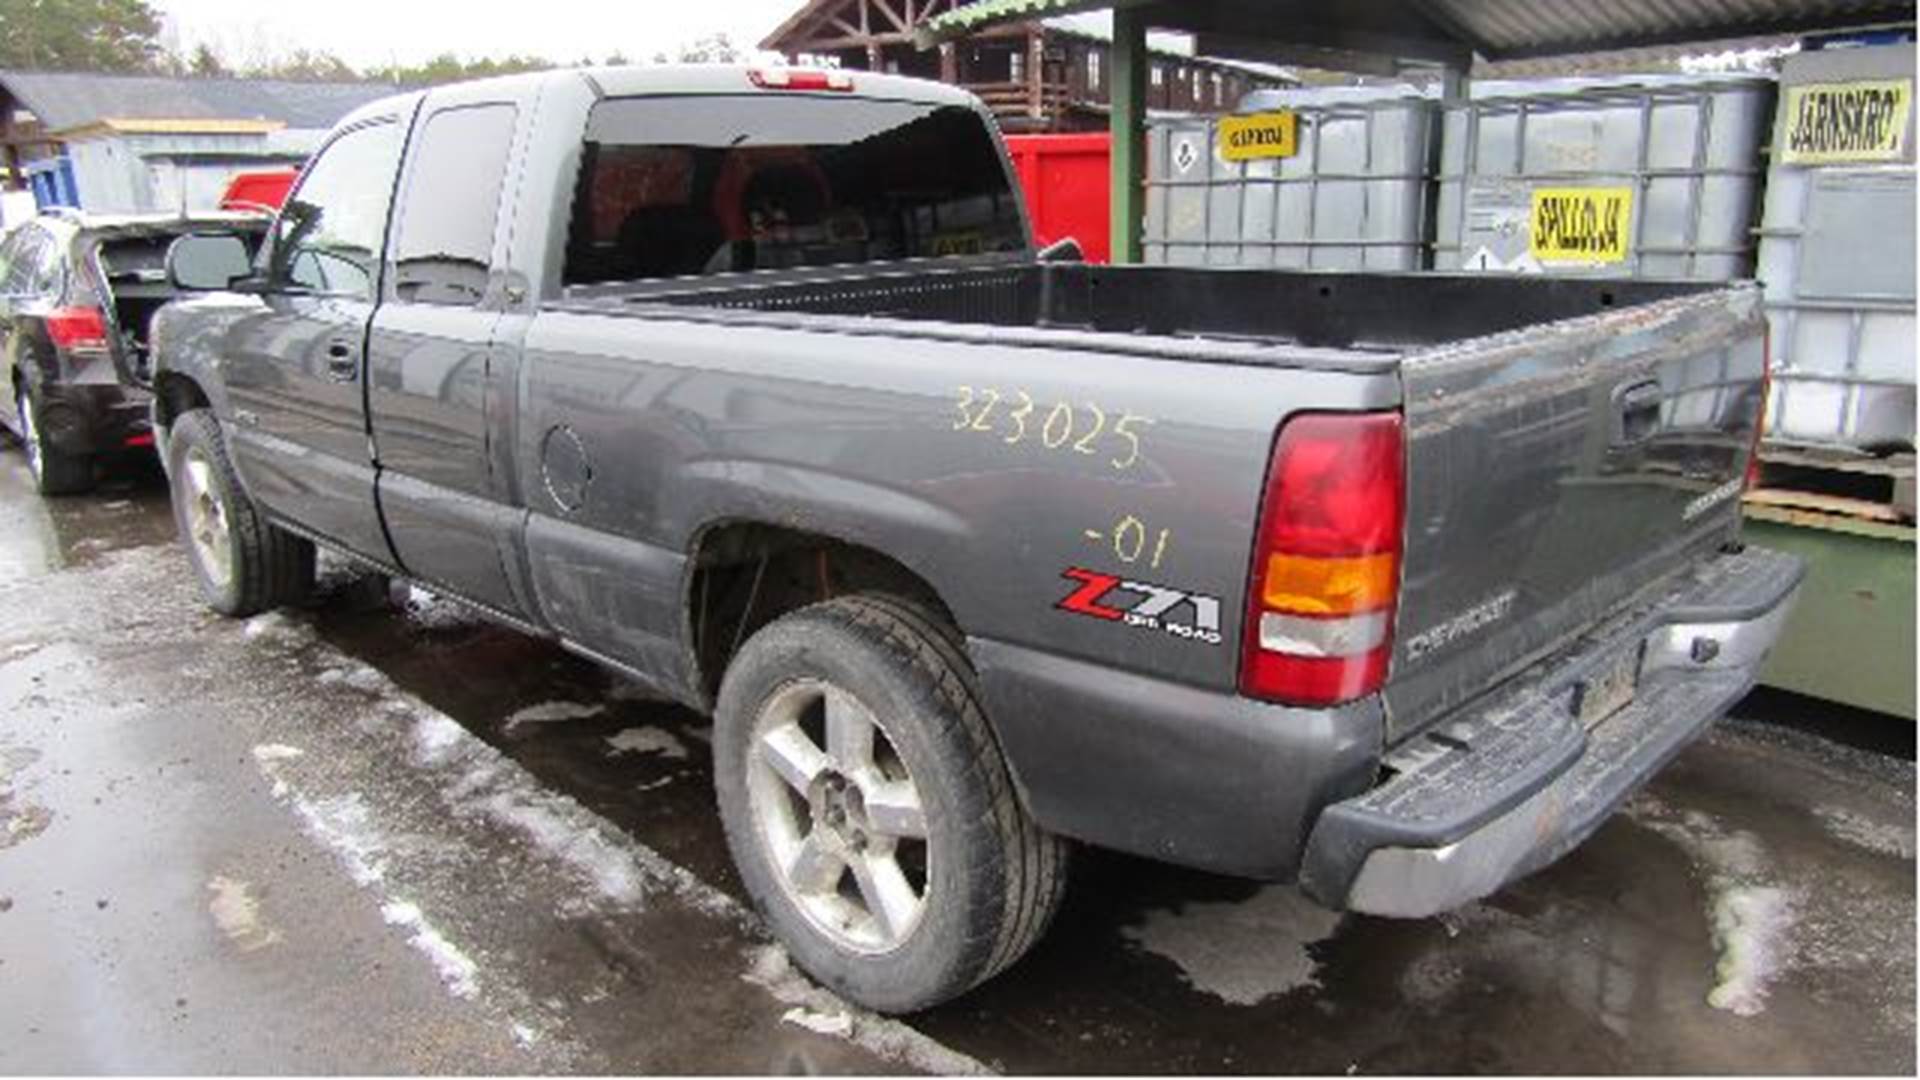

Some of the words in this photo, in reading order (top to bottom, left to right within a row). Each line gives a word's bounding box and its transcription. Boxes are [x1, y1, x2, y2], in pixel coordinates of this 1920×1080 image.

[953, 386, 1156, 469] 323025
[1085, 514, 1170, 568] -01
[1053, 566, 1223, 632] Z71
